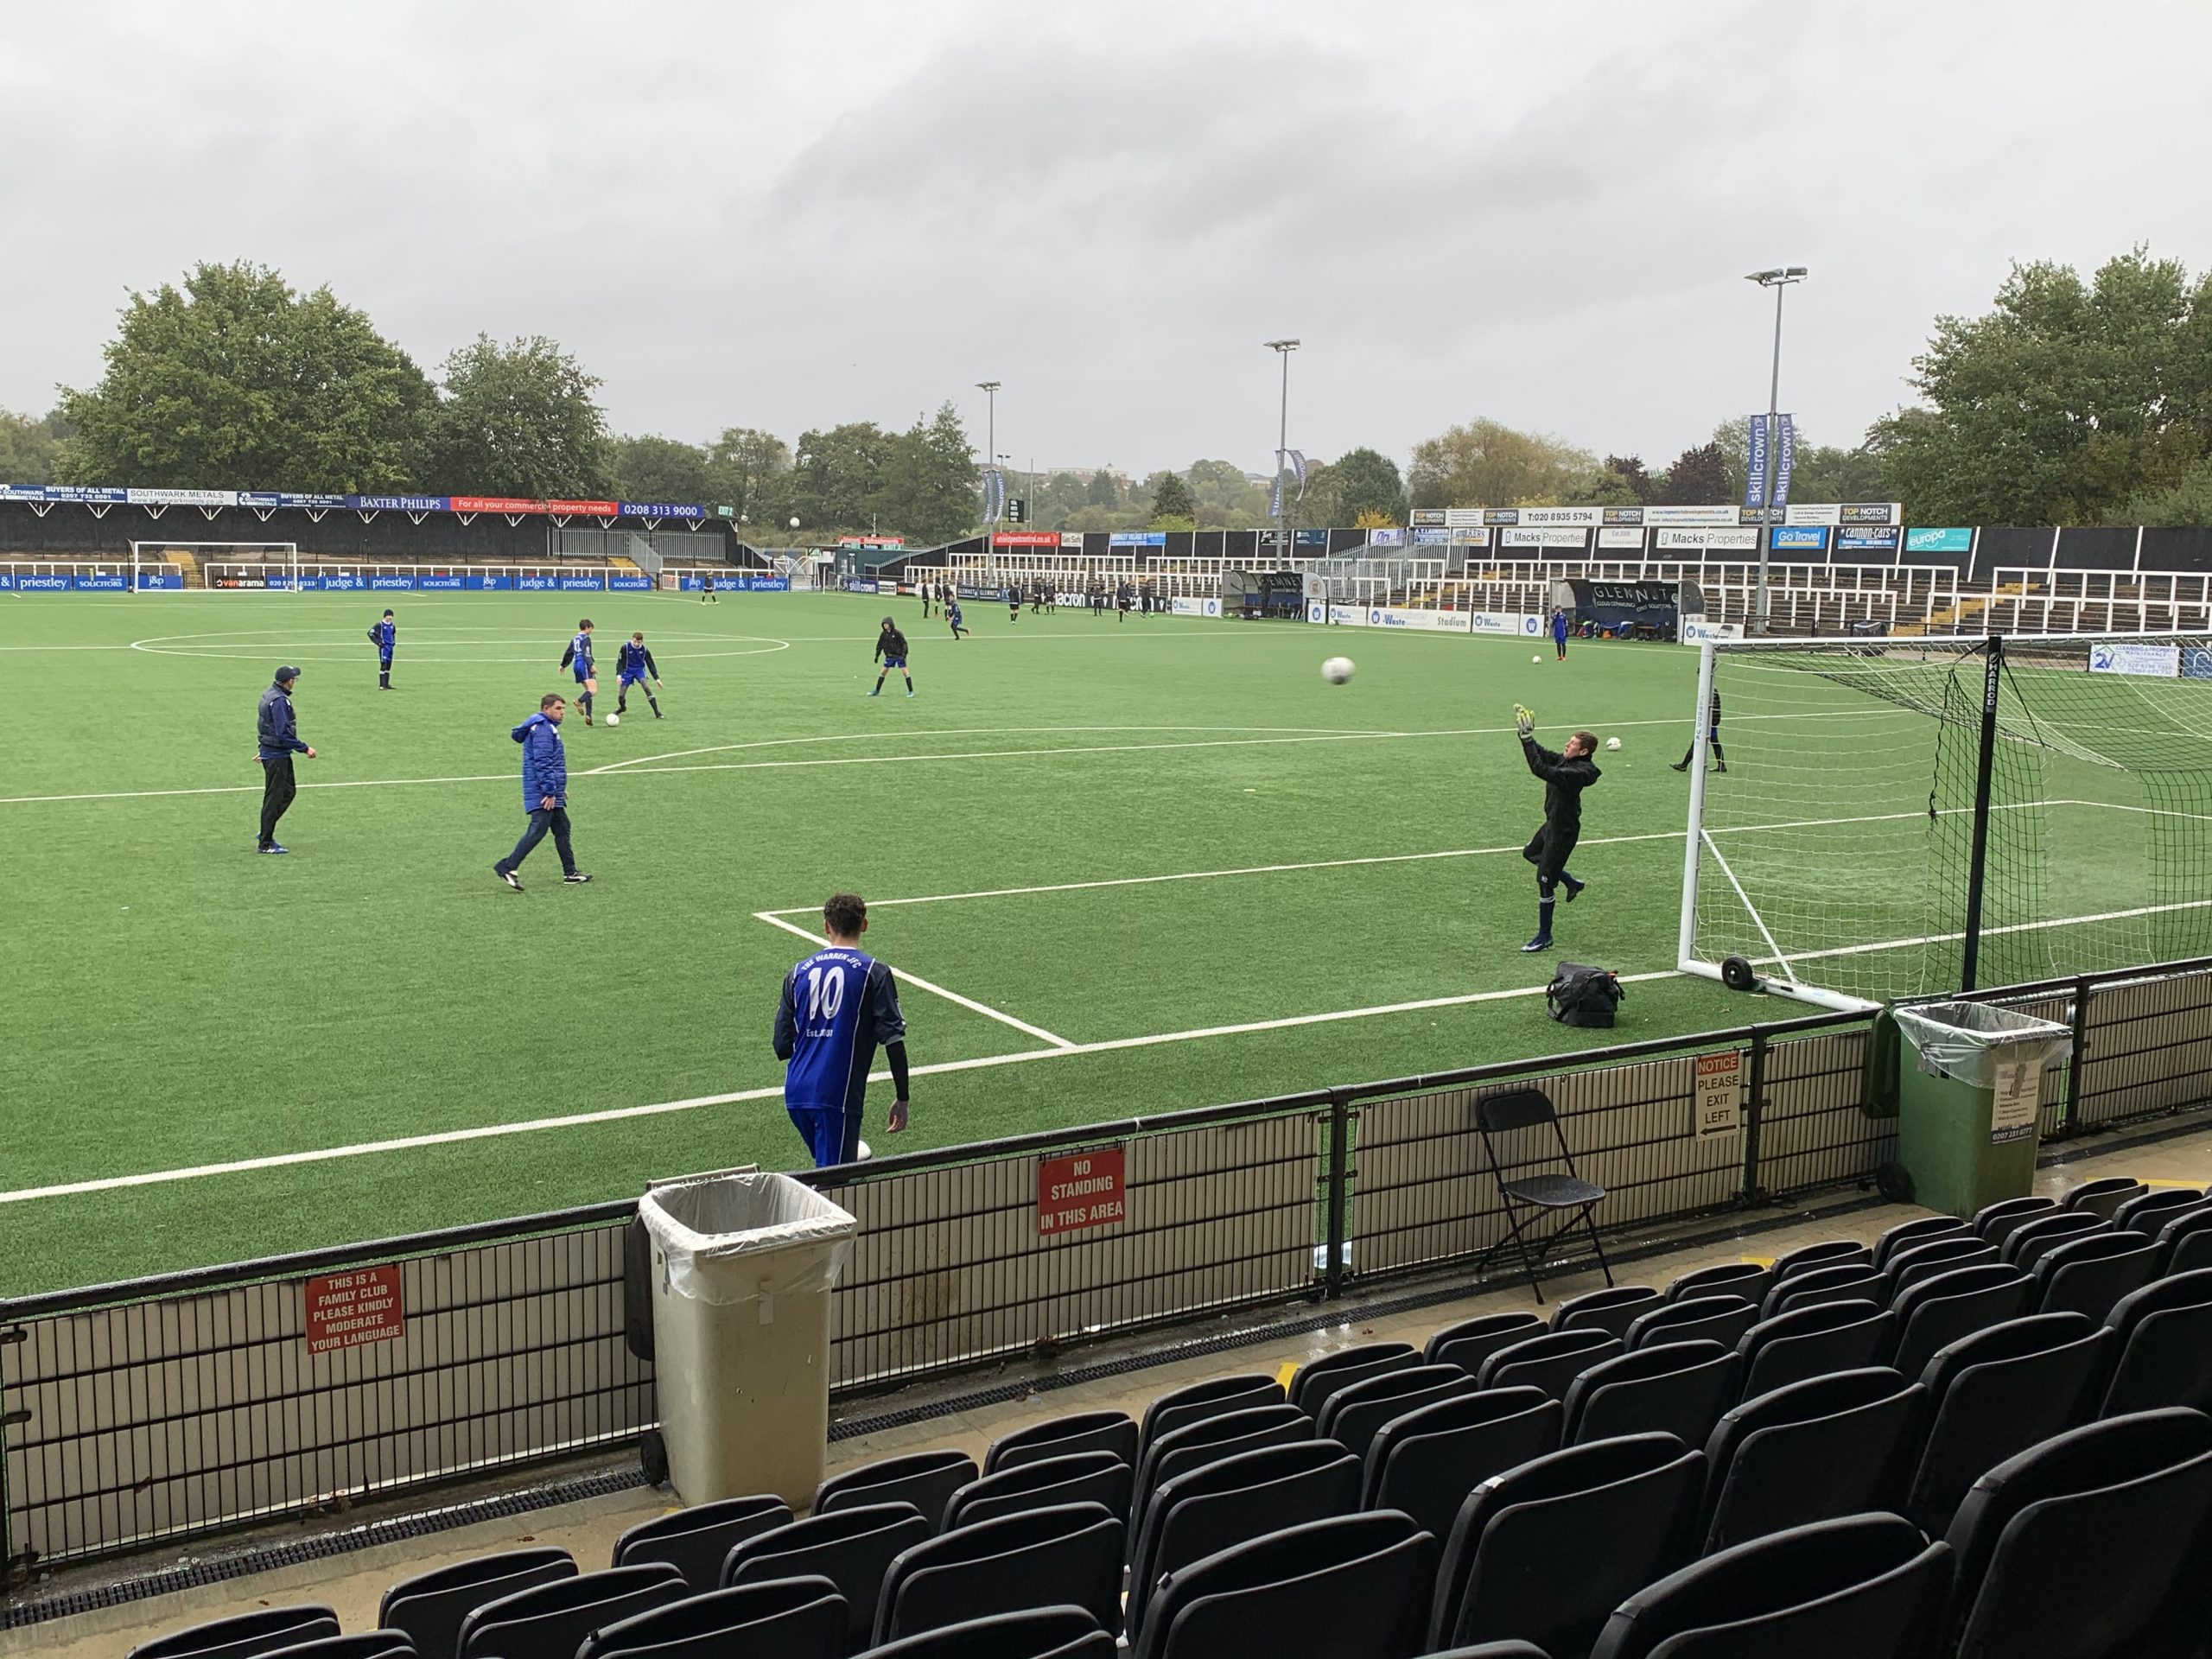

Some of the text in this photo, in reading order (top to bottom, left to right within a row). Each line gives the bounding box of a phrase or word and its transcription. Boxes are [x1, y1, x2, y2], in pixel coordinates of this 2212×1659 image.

[1749, 428, 1765, 502] skillcrown
[1777, 427, 1791, 501] skillcrown
[360, 496, 441, 509] BAXTER PHILIPS
[485, 502, 503, 512] your
[505, 502, 550, 511] commercial
[553, 503, 586, 512] property
[588, 504, 611, 512] needs
[624, 505, 697, 516] 0208 313 9000
[719, 506, 733, 516] EXIT 2
[1514, 532, 1585, 543] Macks Properties
[1672, 533, 1756, 545] Macks Properties
[1778, 531, 1821, 542] Go Travel
[1908, 530, 1946, 546] europa
[1, 575, 10, 587] &
[20, 578, 67, 590] priestley
[148, 575, 165, 586] j&p
[325, 578, 353, 590] judge
[355, 577, 364, 587] &
[372, 578, 413, 589] priestley
[482, 576, 497, 587] j&p
[519, 577, 545, 589] judge
[547, 577, 555, 587] &
[563, 577, 600, 589] priestley
[689, 577, 701, 587] j&p
[714, 579, 785, 590] judge & priestley
[1437, 616, 1466, 626] Stadium
[1484, 618, 1501, 627] Waste
[1697, 629, 1718, 639] Waste
[1987, 663, 1998, 706] HARROD
[801, 952, 862, 971] THE WARREN JFC
[808, 966, 845, 1020] 10
[1698, 1056, 1738, 1074] NOTICE
[1698, 1075, 1739, 1092] PLEASE
[1707, 1093, 1730, 1107] EXIT
[1705, 1109, 1731, 1124] LEFT
[1993, 1132, 2009, 1141] 0207
[1073, 1160, 1091, 1177] NO
[1051, 1175, 1114, 1201] STANDING
[1040, 1200, 1124, 1230] IN THIS AREA
[327, 1272, 378, 1290] THIS IS A
[318, 1284, 388, 1306] FAMILY CLUB
[313, 1297, 394, 1322] PLEASE KINDLY
[325, 1314, 384, 1335] MODERATE
[311, 1325, 400, 1351] YOUR LANGUAGE
